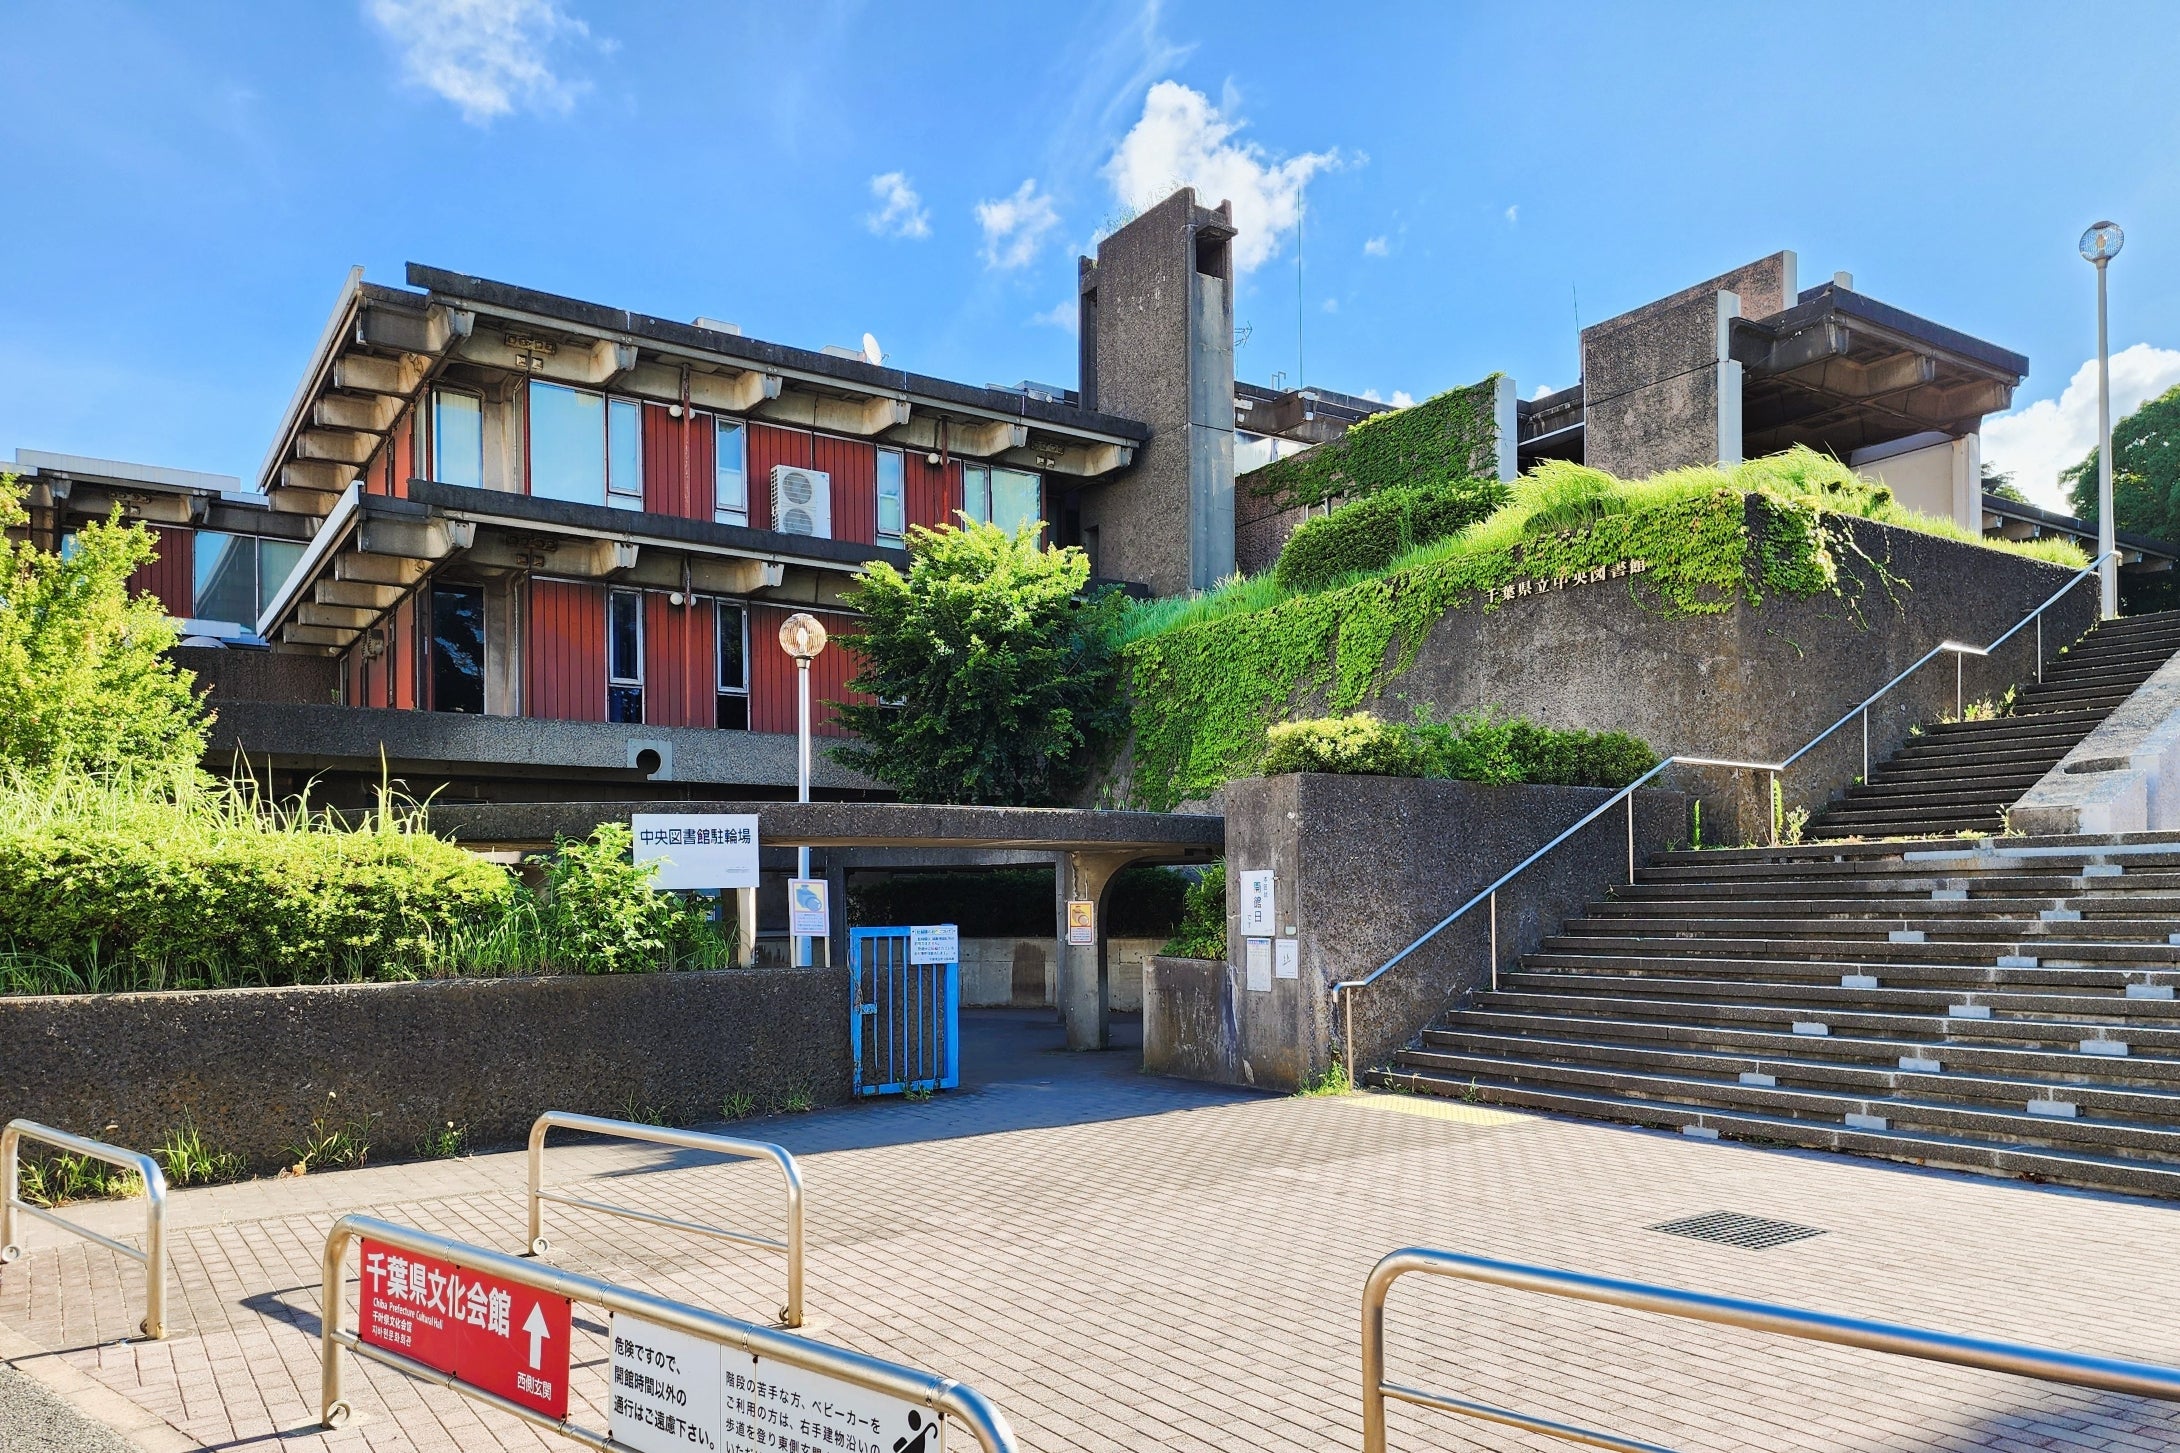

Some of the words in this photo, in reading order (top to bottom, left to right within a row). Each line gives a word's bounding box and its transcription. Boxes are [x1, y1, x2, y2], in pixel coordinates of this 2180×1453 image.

[1484, 558, 1646, 603] 千葉県立中央図書館
[640, 828, 751, 846] 中央図書館駐輪場
[366, 1252, 512, 1338] 千葉県文化会館
[373, 1297, 388, 1310] Chiba
[388, 1302, 415, 1319] Prefecture
[416, 1310, 434, 1326] Cultural
[433, 1317, 443, 1330] Hall
[614, 1336, 681, 1375] 危険ですので、
[517, 1371, 552, 1401] 西側玄関
[614, 1365, 687, 1407] 開館時間以外の
[725, 1371, 881, 1435] 階段の苦手な方、ベビーカーを
[614, 1394, 715, 1450] 通行はご遠慮下さい。
